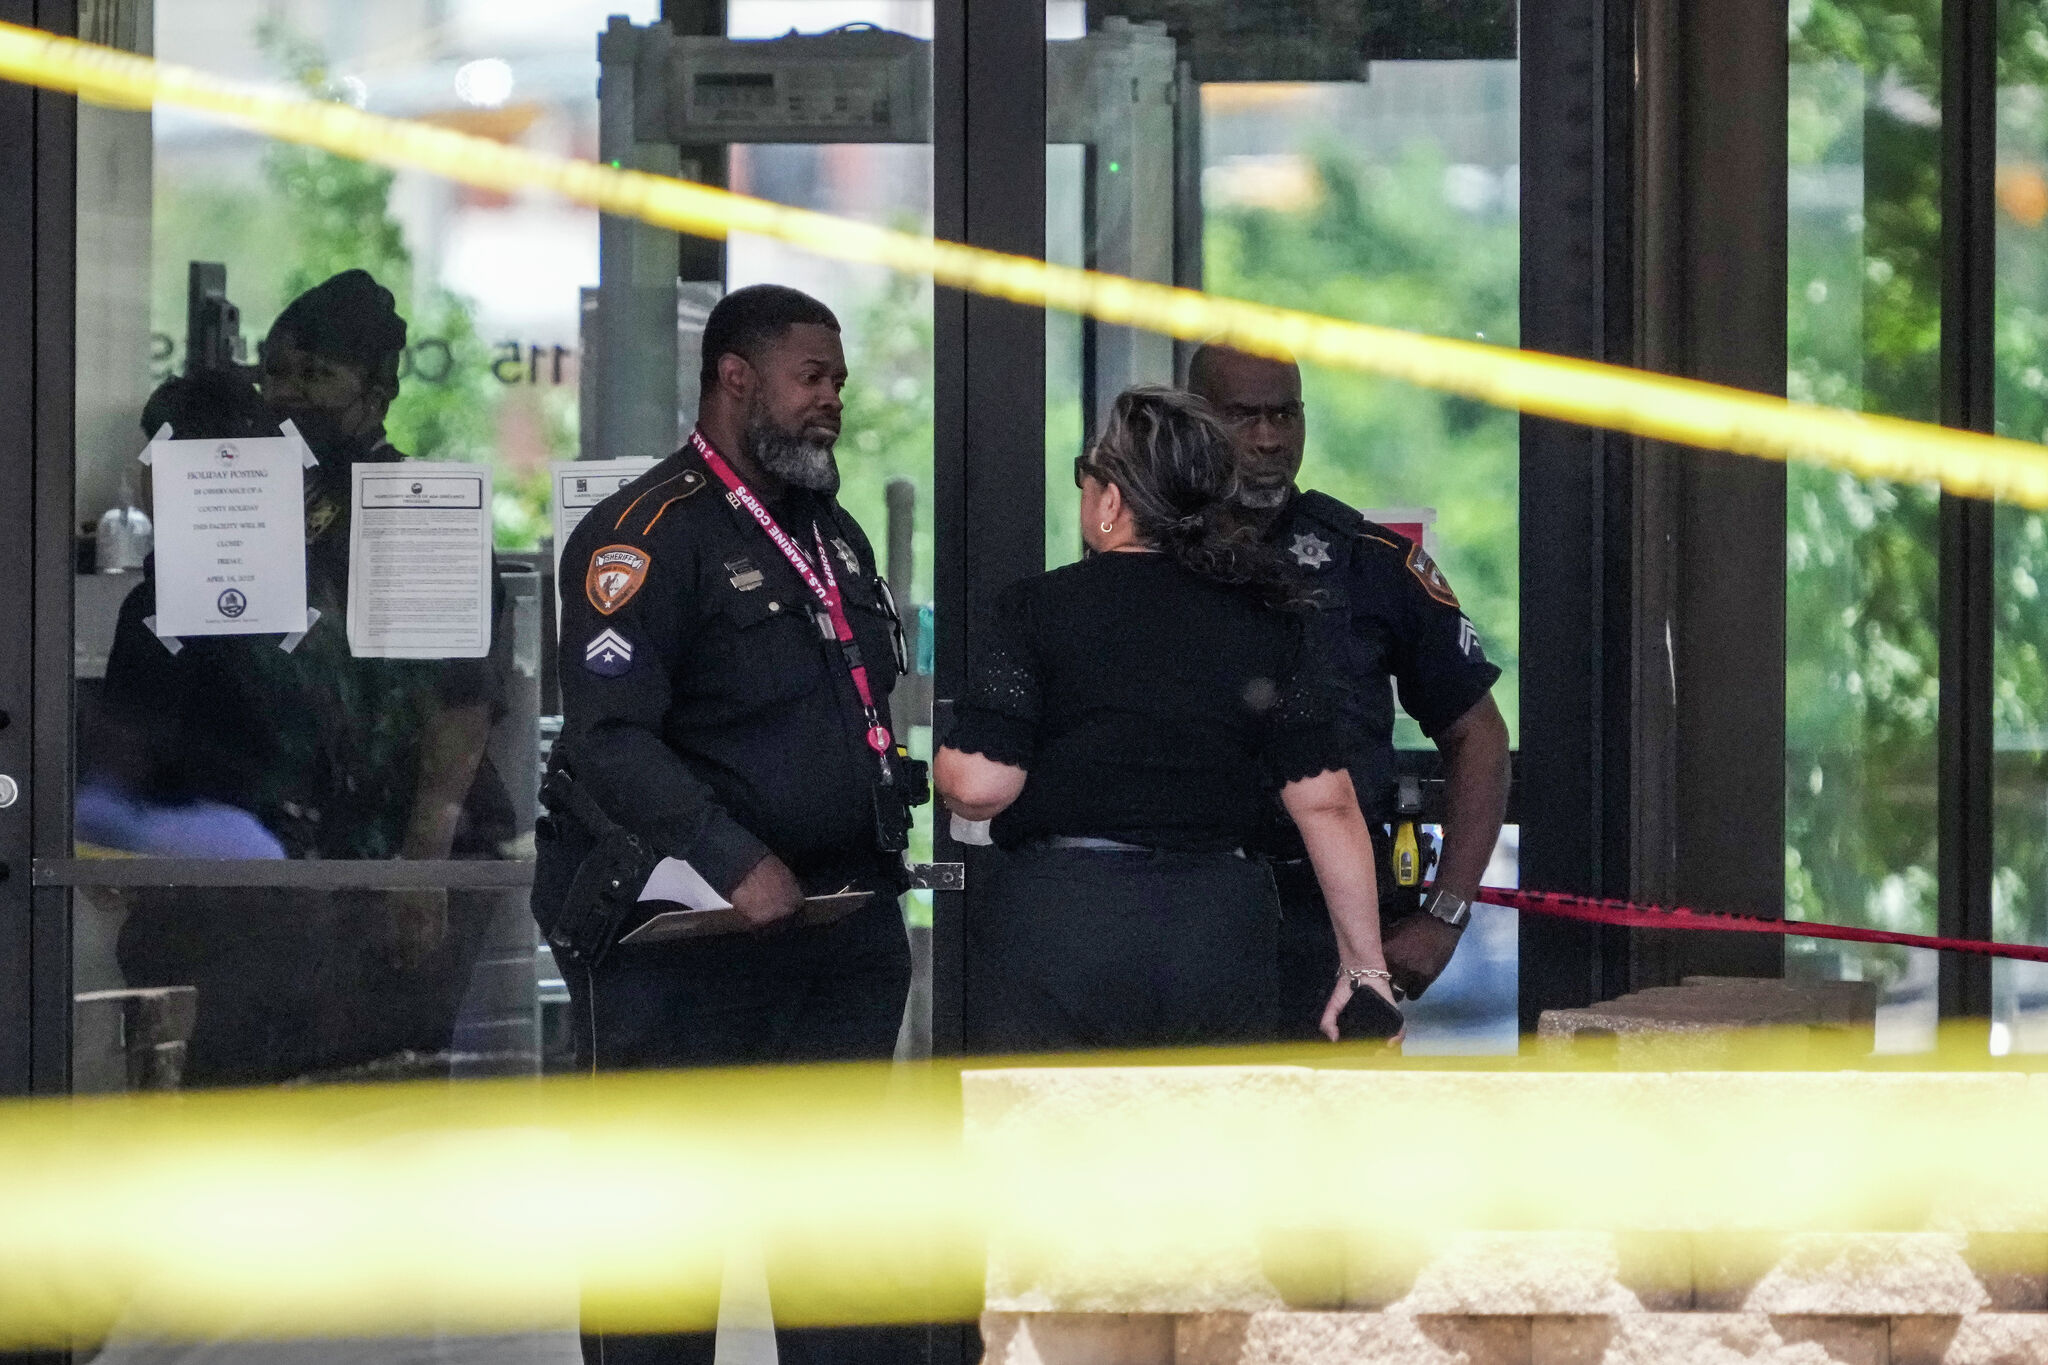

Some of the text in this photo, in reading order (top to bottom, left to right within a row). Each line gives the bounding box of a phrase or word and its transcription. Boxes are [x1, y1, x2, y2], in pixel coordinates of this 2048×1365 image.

[187, 470, 269, 479] HOLIDAY POSTING
[735, 485, 771, 526] CORPS
[604, 551, 635, 561] SHERIFF
[768, 526, 809, 574] MARINE
[818, 546, 837, 588] CORPS
